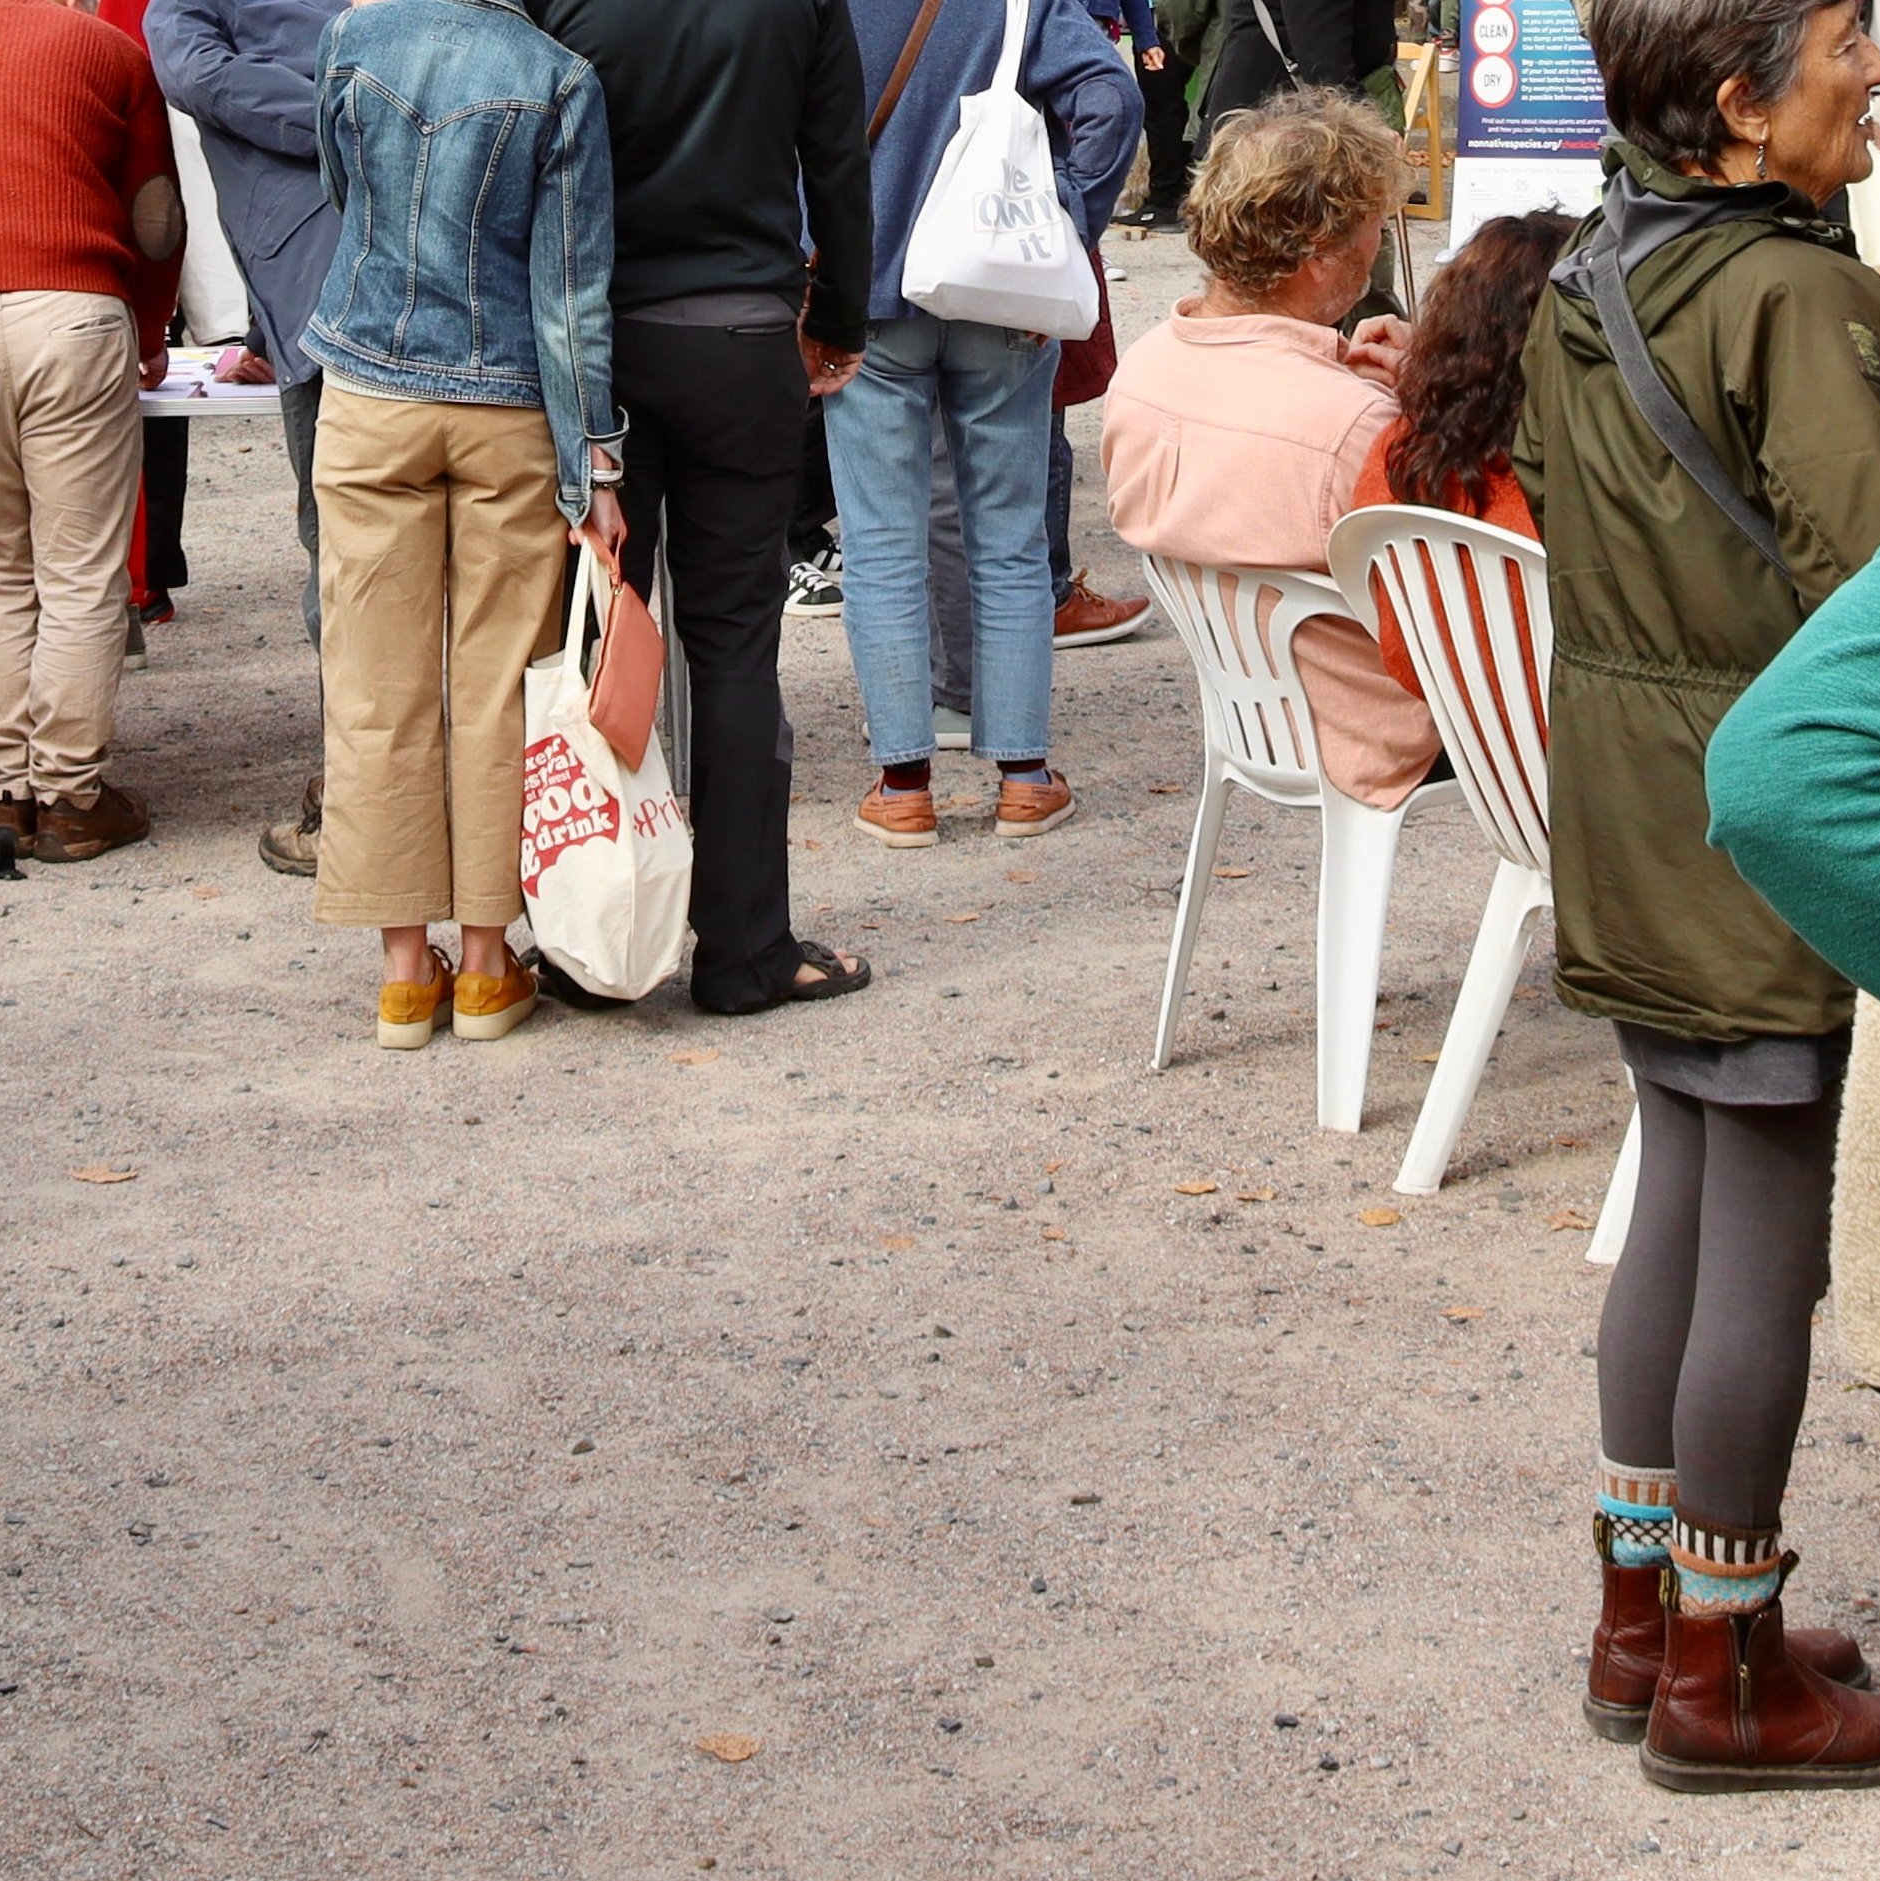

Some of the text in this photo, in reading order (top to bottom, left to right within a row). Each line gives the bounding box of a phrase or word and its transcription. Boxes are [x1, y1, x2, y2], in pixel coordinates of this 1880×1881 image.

[1479, 24, 1509, 39] CLEAN
[1483, 74, 1501, 87] DRY
[1018, 231, 1052, 262] it
[535, 808, 615, 852] drink
